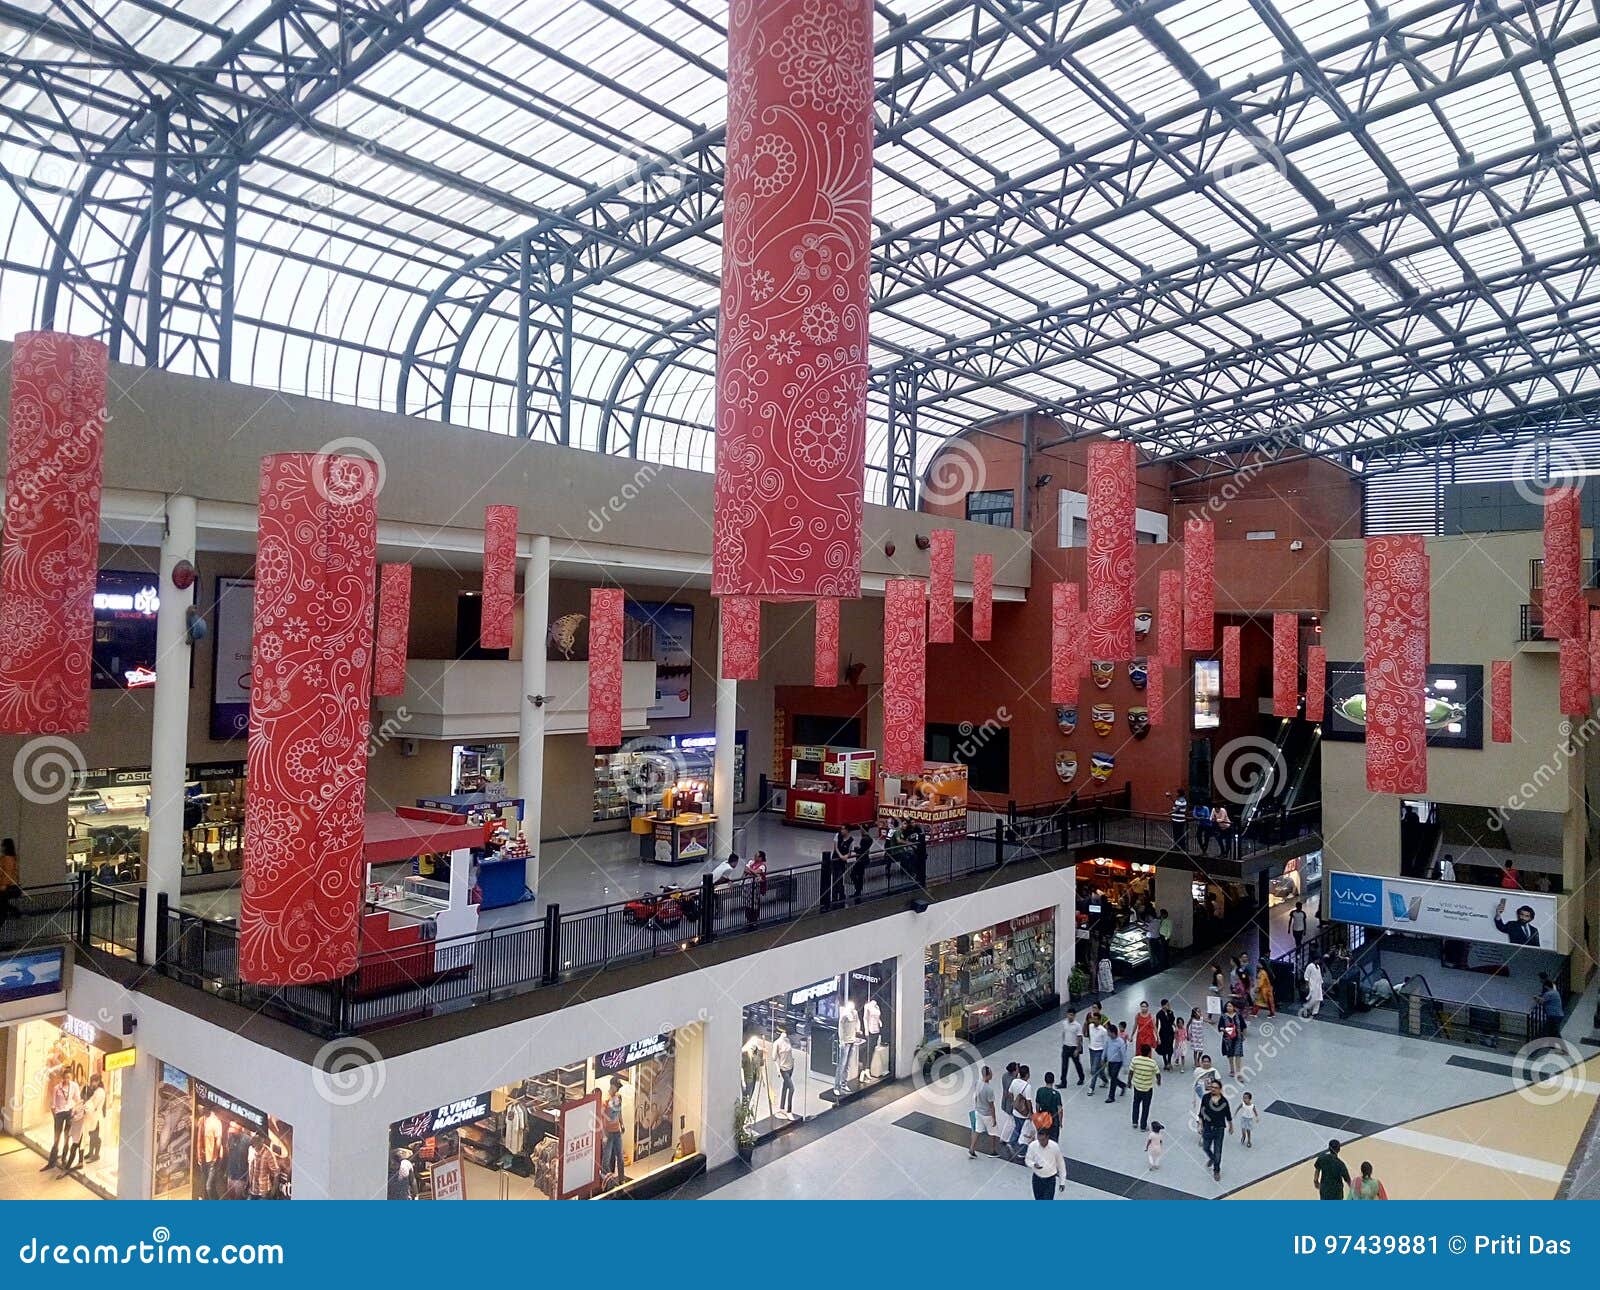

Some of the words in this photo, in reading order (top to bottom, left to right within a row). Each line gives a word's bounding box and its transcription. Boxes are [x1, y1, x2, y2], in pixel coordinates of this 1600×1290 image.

[1334, 888, 1377, 903] vivo
[625, 1041, 666, 1064] MACHINE
[629, 1034, 659, 1053] FLYING
[207, 1090, 231, 1110] FLYING
[231, 1102, 264, 1126] MACHINE
[432, 1103, 487, 1131] MACHINE
[437, 1096, 478, 1119] FLYING
[569, 1136, 590, 1153] SALE
[436, 1168, 459, 1189] FLAT
